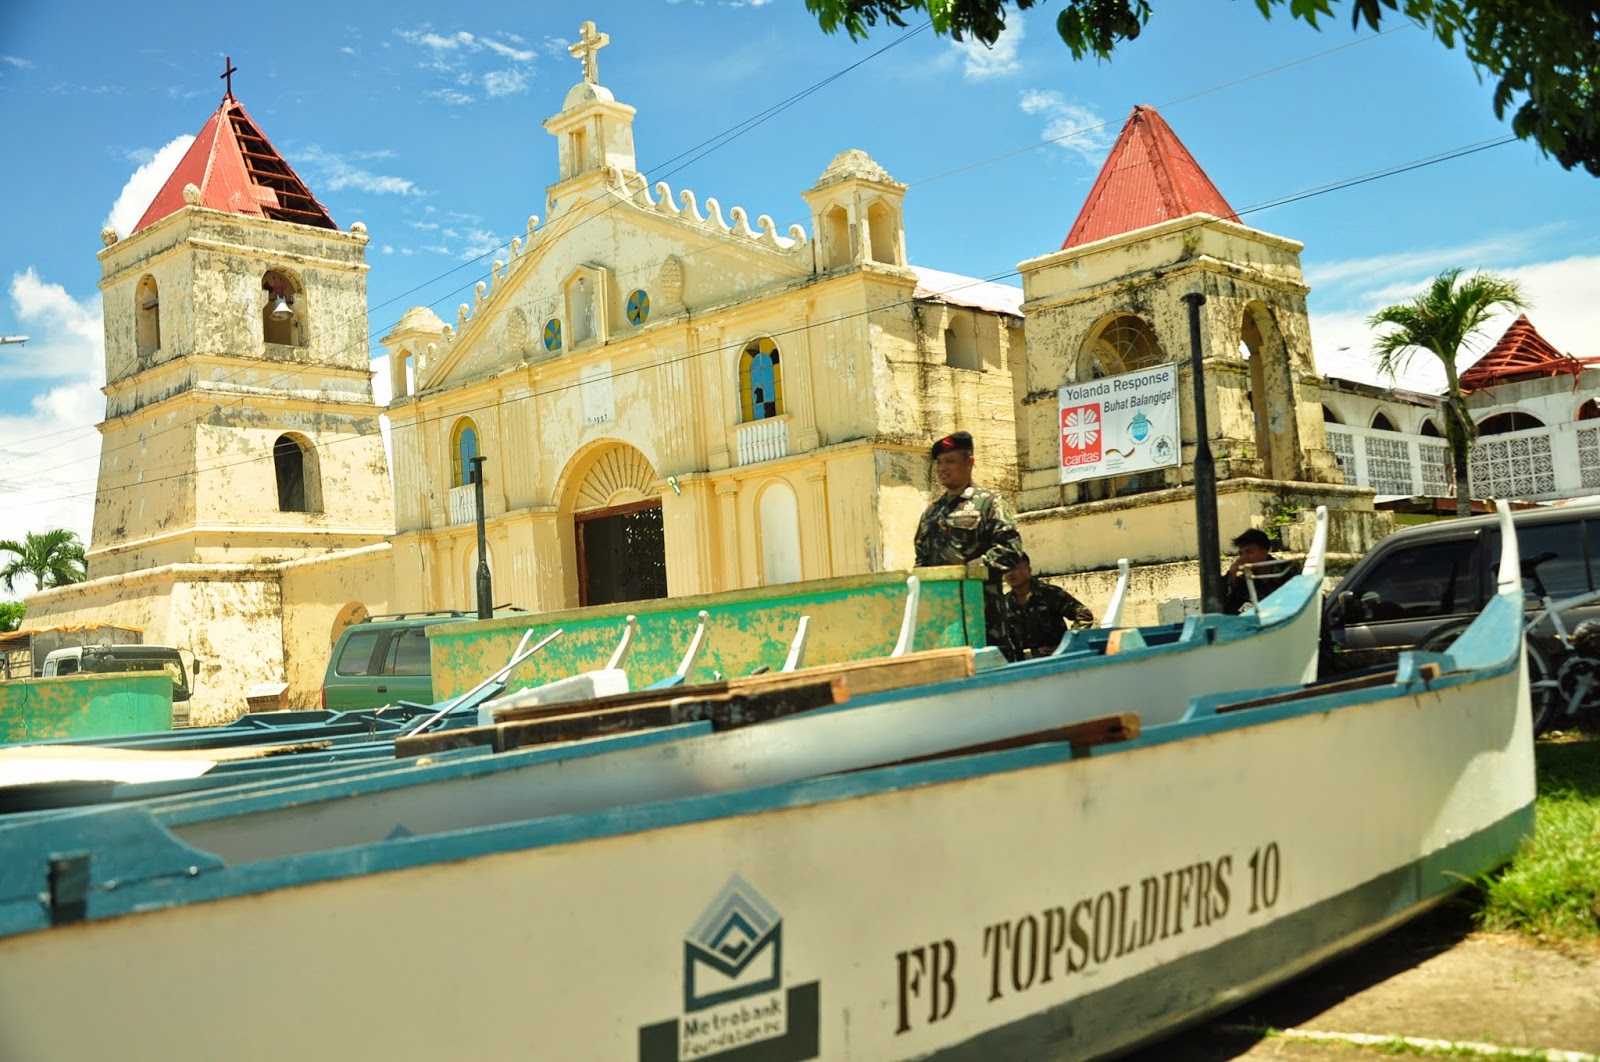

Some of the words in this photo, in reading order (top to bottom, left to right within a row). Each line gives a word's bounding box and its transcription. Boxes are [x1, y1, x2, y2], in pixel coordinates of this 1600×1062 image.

[1067, 383, 1110, 400] Yolanda
[1114, 372, 1169, 392] Response
[1104, 400, 1128, 413] Buhat
[1065, 451, 1100, 466] caritas
[1066, 465, 1097, 474] Germany
[895, 938, 957, 1036] FB
[1247, 841, 1280, 914] 10
[684, 997, 781, 1039] Metrobank
